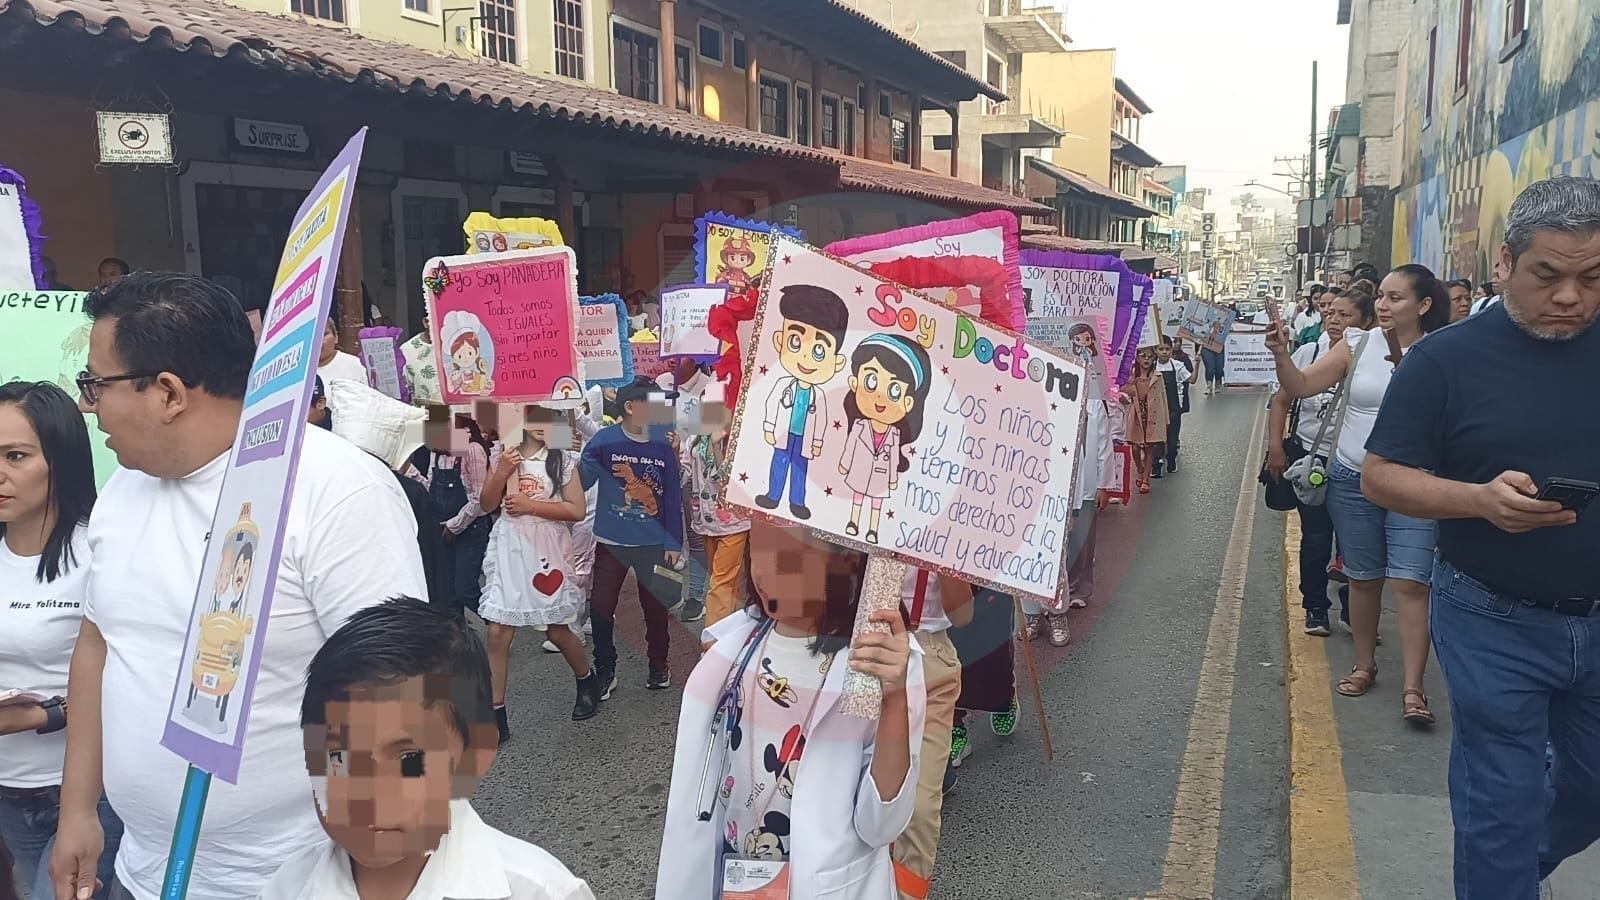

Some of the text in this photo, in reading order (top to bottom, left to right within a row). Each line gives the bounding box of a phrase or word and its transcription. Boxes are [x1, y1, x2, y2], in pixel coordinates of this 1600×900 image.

[248, 124, 299, 149] SURPRISE
[718, 228, 735, 238] SOY
[742, 229, 770, 245] BOMB
[1202, 214, 1213, 258] HOTEL
[934, 238, 960, 257] Soy
[476, 271, 500, 295] Soy
[503, 262, 565, 285] PANADERA
[1024, 267, 1045, 280] SOY
[1046, 281, 1061, 294] LA
[484, 299, 553, 316] Todos somos
[580, 306, 603, 316] TOR
[1043, 305, 1067, 318] PARA
[1044, 294, 1104, 310] ES LA BASE
[506, 313, 553, 330] IGUALES
[513, 328, 560, 348] importar
[586, 328, 613, 336] QUIEN
[582, 350, 618, 358] MANERA
[953, 315, 1080, 403] Doctora
[999, 406, 1056, 447] niños
[930, 421, 948, 456] y
[957, 425, 987, 460] las
[920, 447, 1067, 522] tenemos los mis
[905, 480, 942, 516] mos
[950, 495, 1016, 537] derechos
[1040, 523, 1057, 553] la
[895, 521, 952, 559] salud
[952, 539, 970, 572] y
